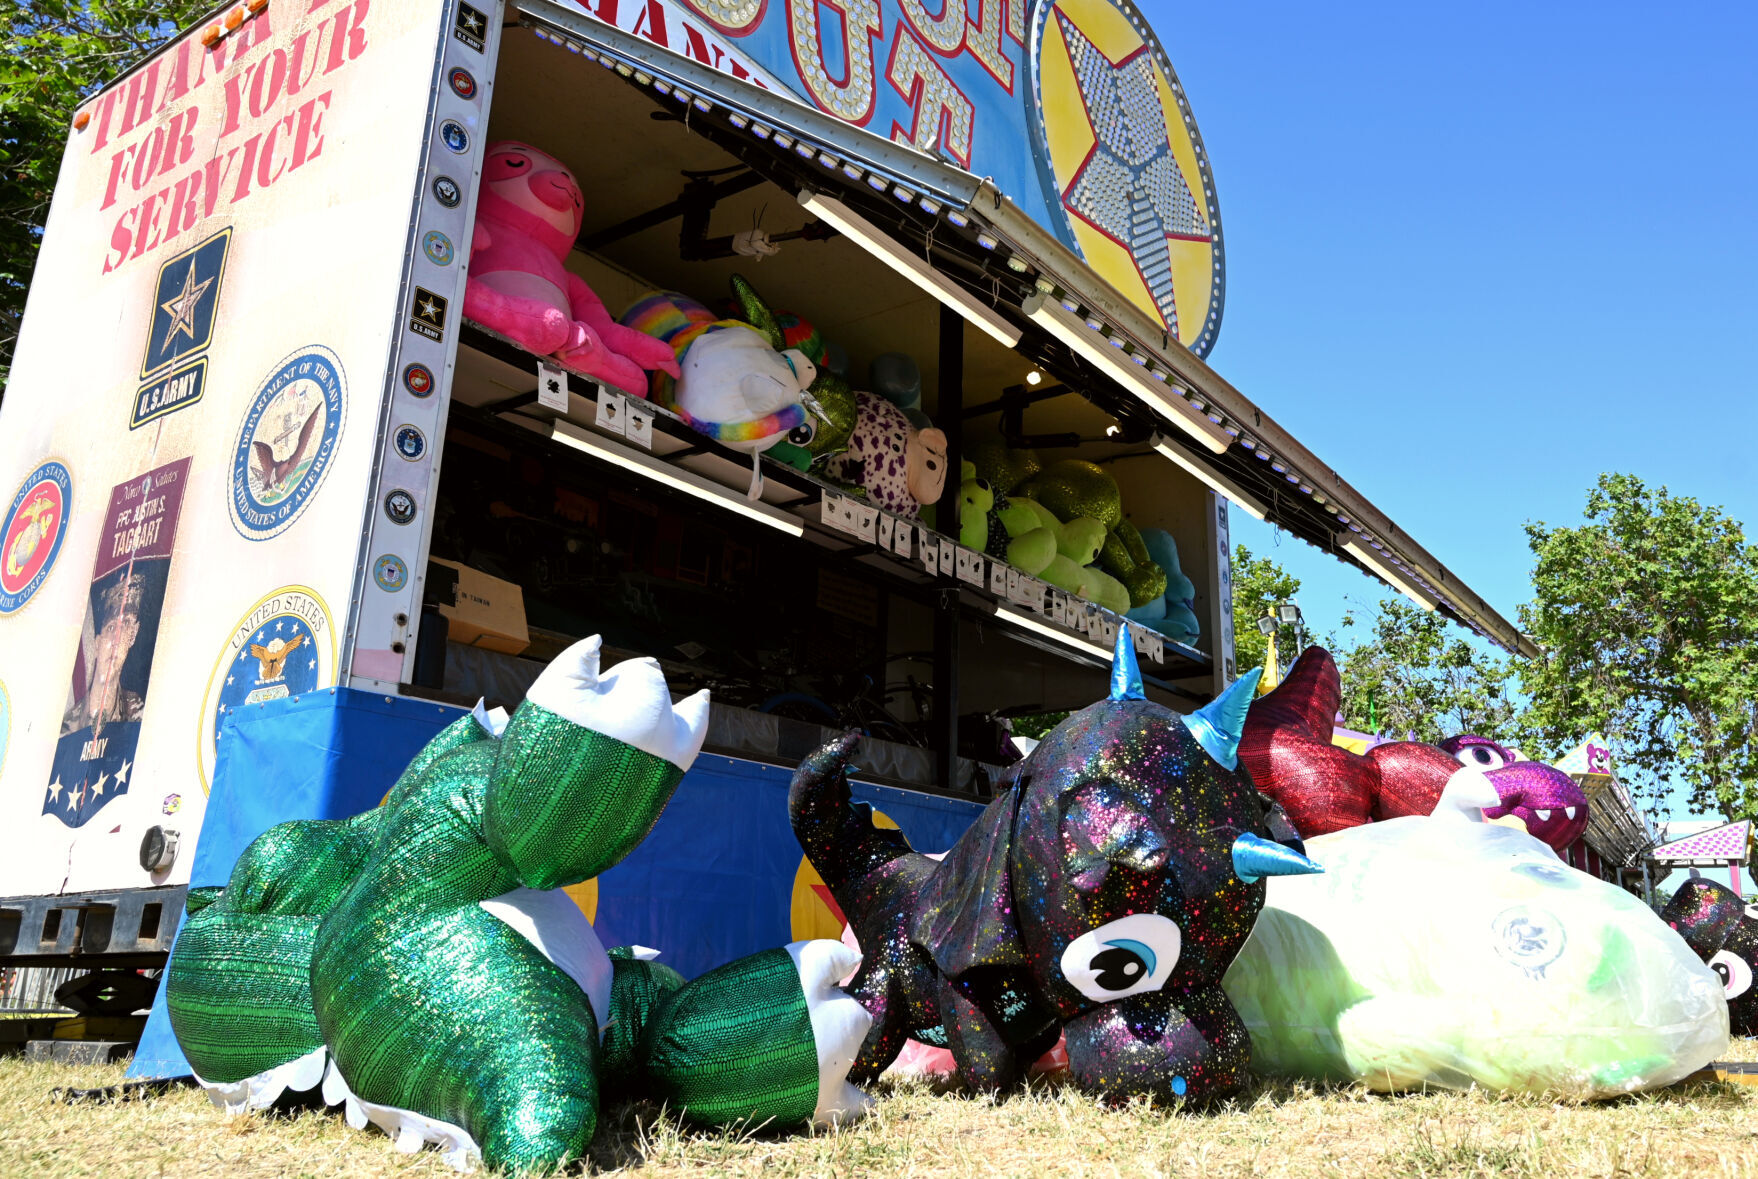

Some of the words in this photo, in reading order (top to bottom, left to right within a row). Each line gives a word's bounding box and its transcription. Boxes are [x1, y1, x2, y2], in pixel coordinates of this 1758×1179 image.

[100, 106, 199, 211] FOR
[219, 0, 370, 138] YOUR
[102, 90, 332, 275] SERVICE
[241, 366, 296, 449] DEPARTMENT
[299, 362, 312, 375] OF
[314, 363, 329, 383] THE
[326, 378, 338, 412] NAVY
[14, 470, 43, 508] UNITED
[46, 466, 68, 489] STATES
[236, 467, 248, 514] UNITED
[246, 506, 276, 526] STATES
[279, 502, 292, 518] OF
[295, 437, 333, 505] AMERICA
[116, 509, 132, 529] PFC
[18, 568, 46, 603] CORPS
[232, 599, 281, 649] UNITED
[284, 595, 325, 632] STATES
